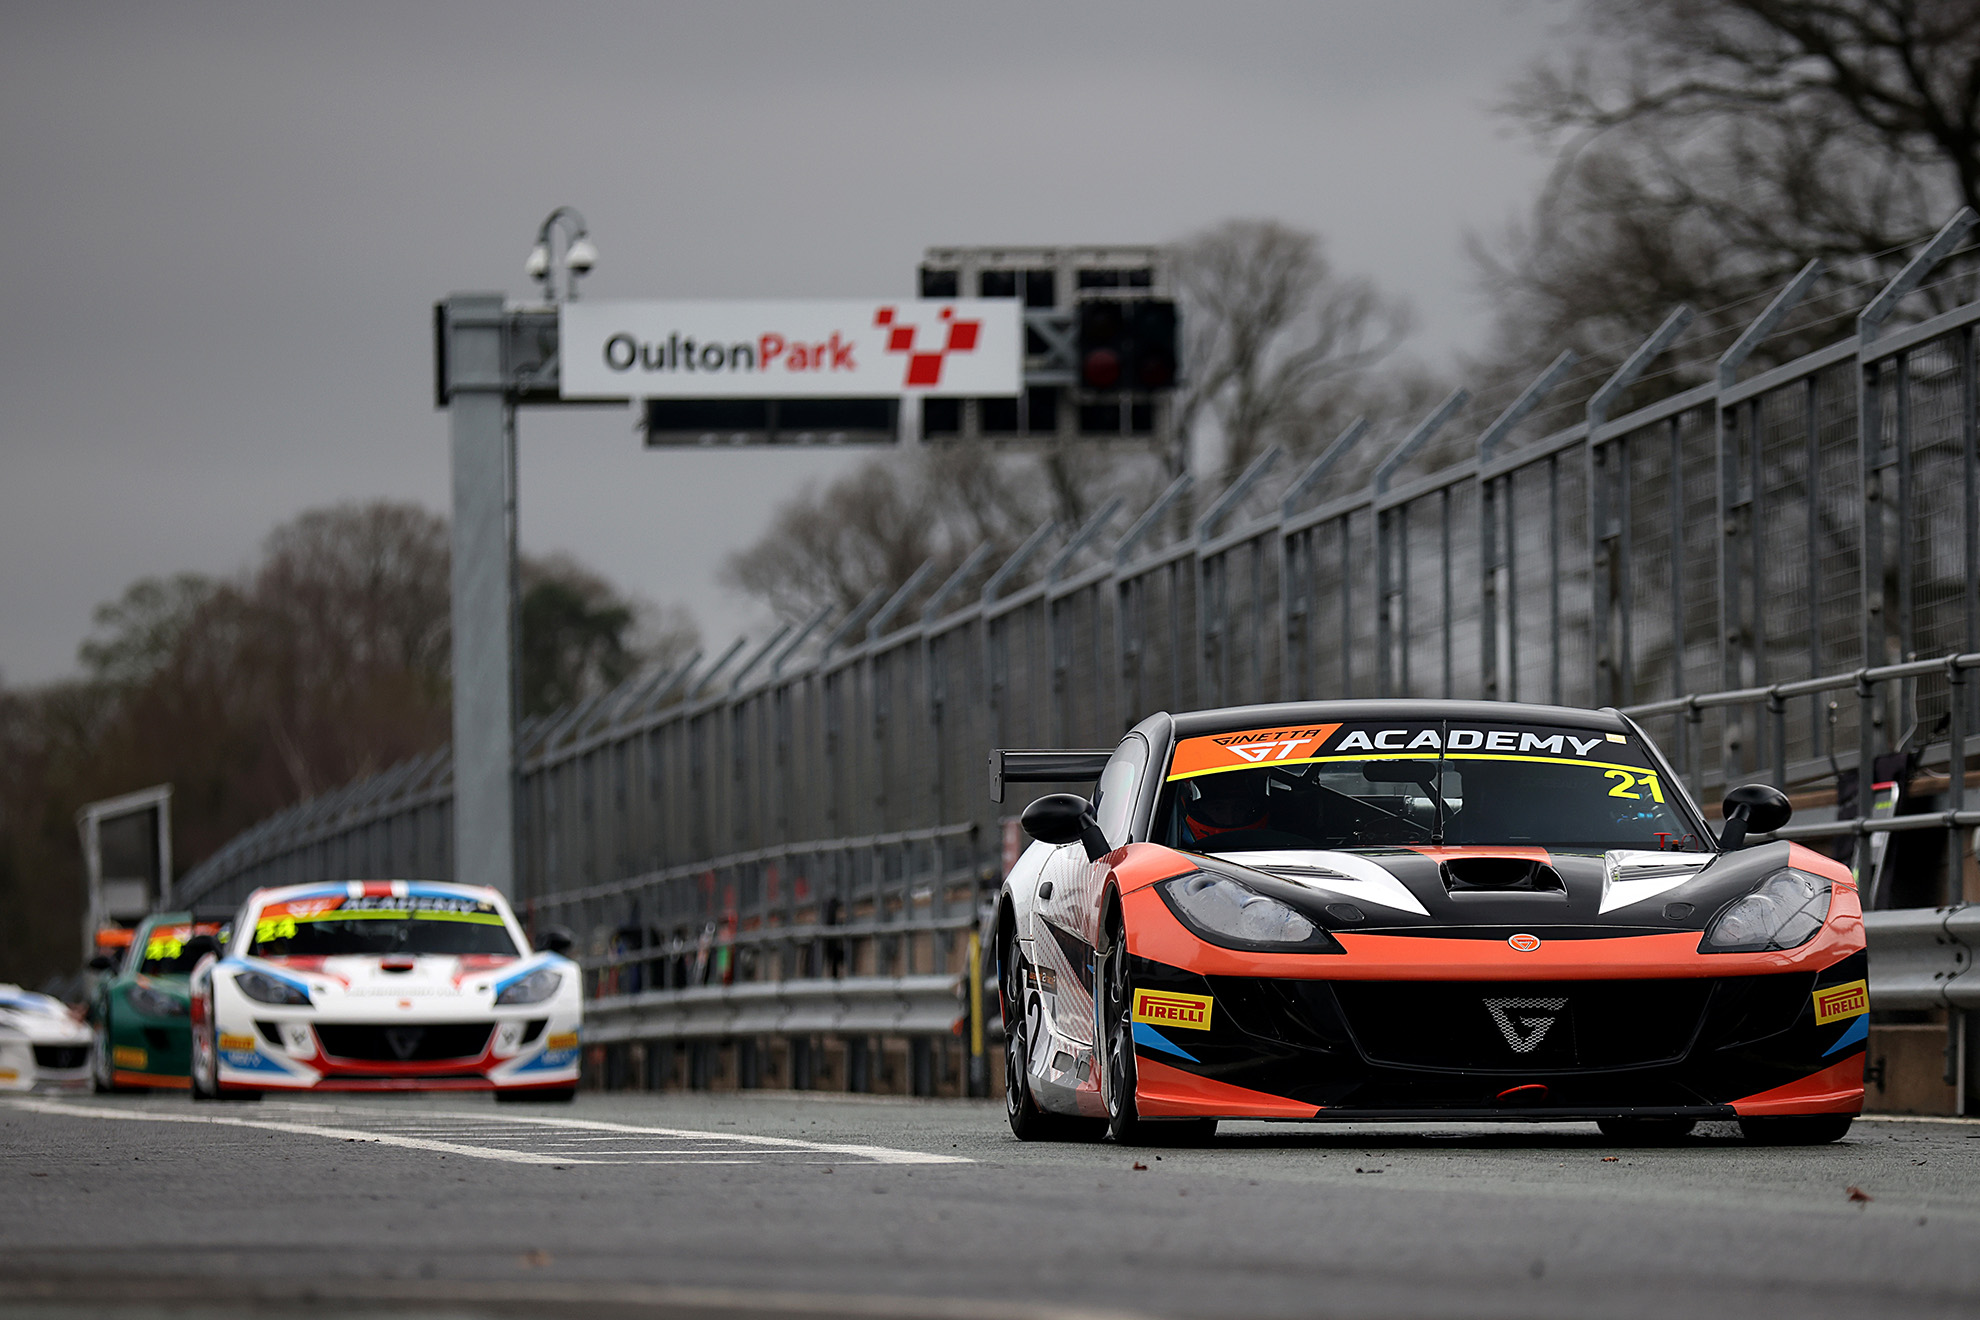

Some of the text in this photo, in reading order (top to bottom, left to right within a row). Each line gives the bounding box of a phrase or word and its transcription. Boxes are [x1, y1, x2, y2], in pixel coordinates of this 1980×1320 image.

[1212, 728, 1321, 746] GINETTA
[1225, 729, 1603, 763] GT ACADEMY
[1604, 769, 1665, 804] 21
[1138, 995, 1206, 1023] PIRELLI
[1819, 987, 1865, 1018] PIRELLI
